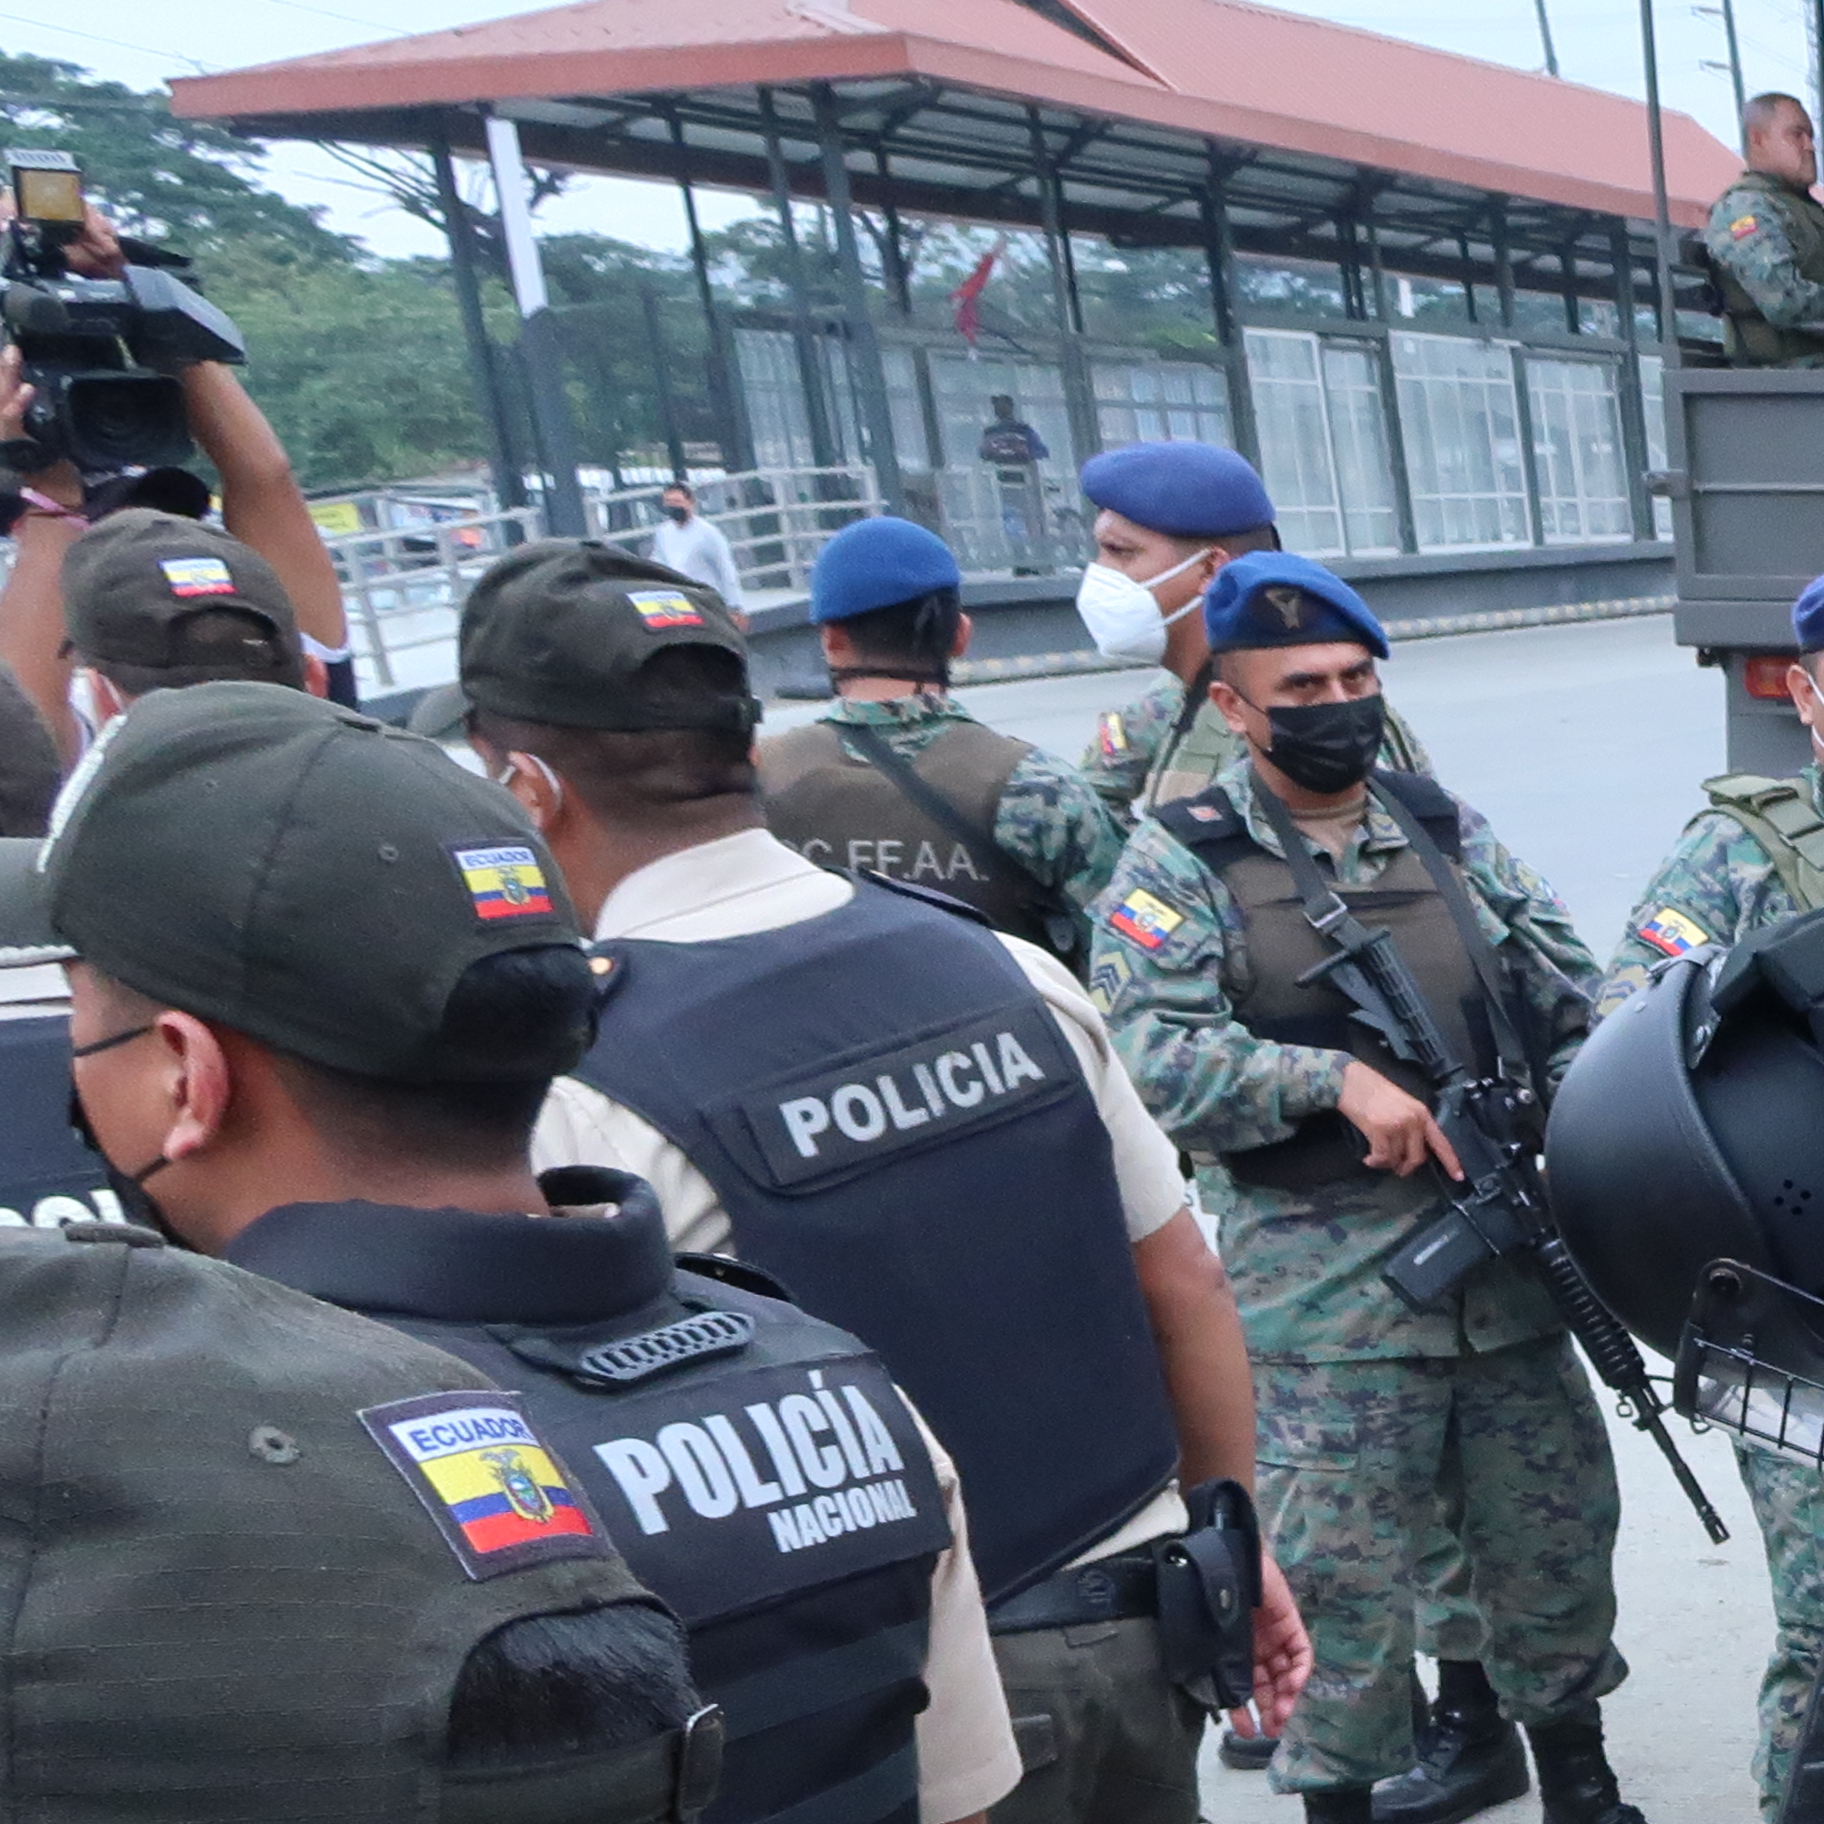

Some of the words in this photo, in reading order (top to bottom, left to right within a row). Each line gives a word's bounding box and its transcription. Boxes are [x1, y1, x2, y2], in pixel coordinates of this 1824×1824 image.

[779, 1032, 1047, 1158] POLICIA
[408, 1417, 535, 1454] ECUADOR
[593, 1370, 904, 1535] POLICÍA
[768, 1479, 918, 1553] NACIONAL
